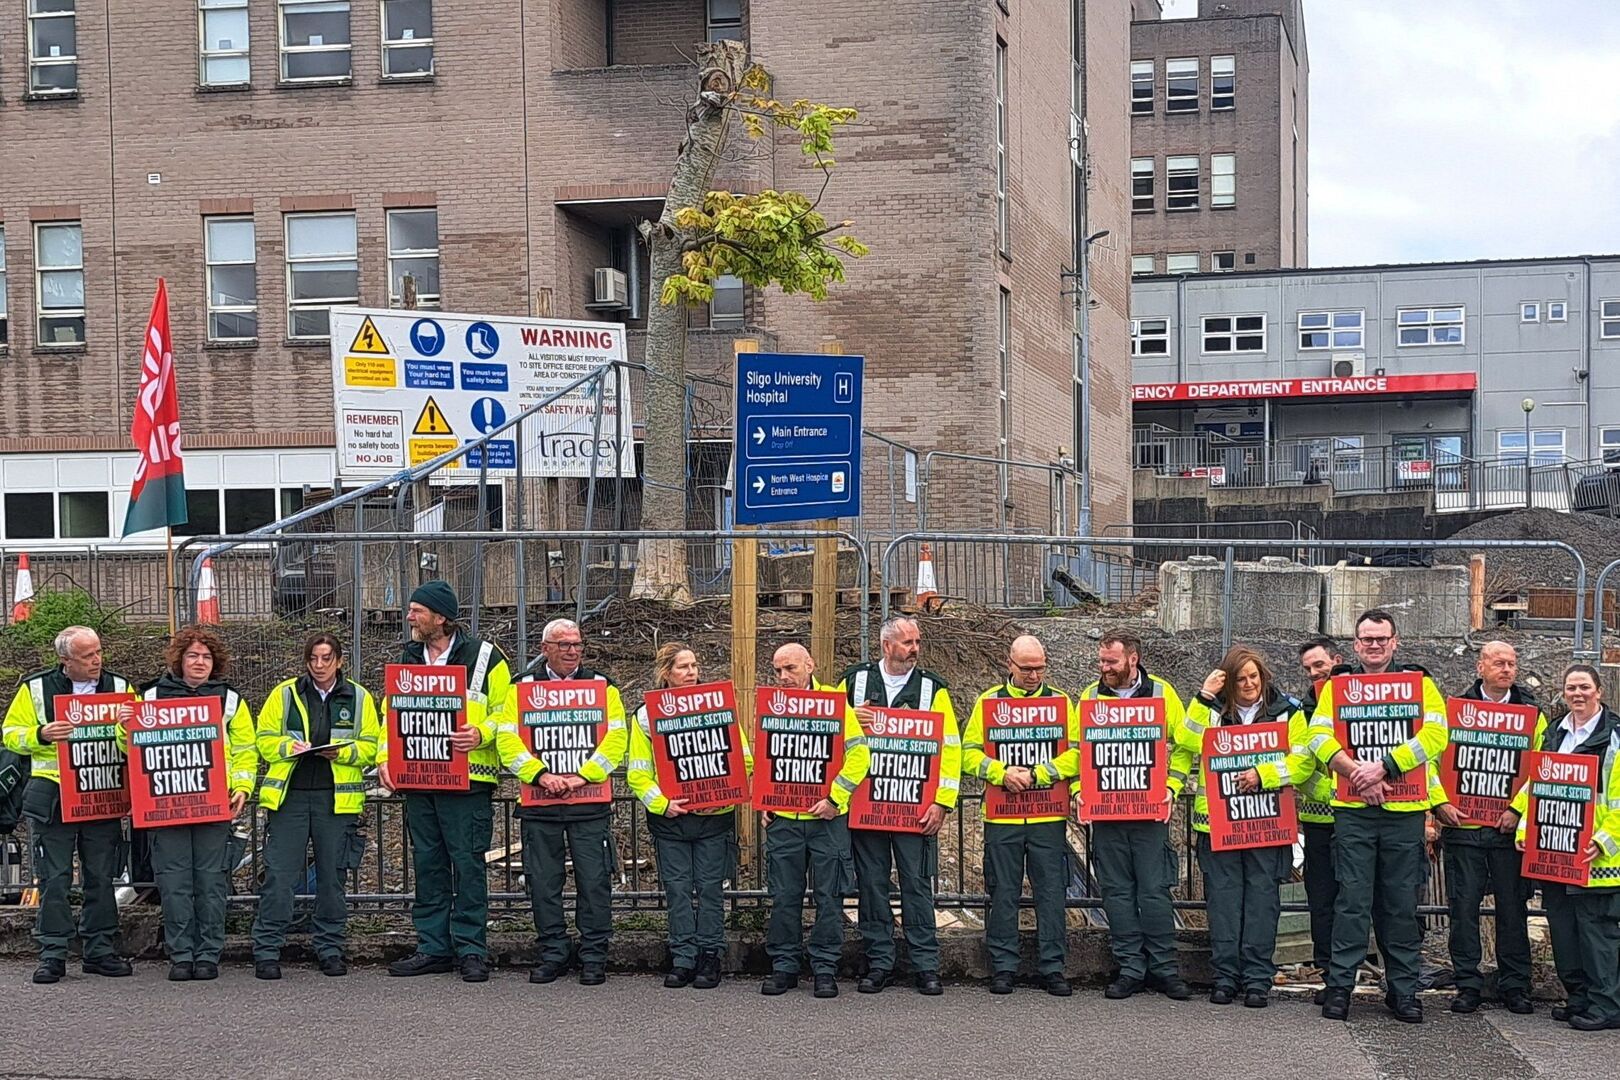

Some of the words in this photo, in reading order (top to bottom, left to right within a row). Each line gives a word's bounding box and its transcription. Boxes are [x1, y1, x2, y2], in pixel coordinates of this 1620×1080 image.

[521, 328, 612, 349] WARNING
[747, 371, 771, 388] Sligo
[775, 372, 821, 389] University
[839, 379, 847, 395] H
[1188, 382, 1292, 397] DEPARTMENT
[1302, 379, 1386, 392] ENTRANCE
[747, 390, 788, 406] Hospital
[545, 405, 572, 414] SAFETY
[576, 406, 584, 414] AT
[347, 415, 399, 425] REMEMBER
[772, 426, 791, 437] Main
[794, 426, 827, 436] Entrance
[359, 442, 379, 450] safety
[538, 431, 626, 457] tracey
[772, 441, 783, 449] Drop
[771, 474, 788, 483] North
[790, 474, 804, 482] West
[806, 473, 828, 483] Hospice
[771, 487, 797, 496] Entrance
[414, 676, 455, 692] SIPTU
[1364, 683, 1412, 701] SIPTU
[392, 696, 434, 708] AMBULANCE
[436, 697, 461, 708] SECTOR
[548, 689, 595, 706] SIPTU
[677, 691, 723, 712] SIPTU
[84, 704, 120, 721] SIPT
[788, 698, 834, 715] SIPTU
[1012, 706, 1057, 723] SIPTU
[1110, 706, 1154, 723] SIPTU
[1341, 706, 1387, 719] AMBULANCE
[1389, 705, 1418, 717] SECTOR
[159, 706, 209, 725] SIPTU
[401, 712, 454, 735] OFFICIAL
[524, 712, 571, 724] AMBULANCE
[573, 711, 602, 722] SECTOR
[657, 716, 703, 732] AMBULANCE
[704, 711, 733, 726] SECTOR
[1477, 711, 1524, 731] SIPTU
[762, 718, 808, 731] AMBULANCE
[811, 720, 839, 732] SECTOR
[888, 718, 933, 736] SIPTU
[989, 728, 1034, 740] AMBULANCE
[1036, 727, 1063, 738] SECTOR
[1086, 728, 1131, 740] AMBULANCE
[1133, 727, 1160, 738] SECTOR
[133, 730, 184, 744] AMBULANCE
[186, 727, 217, 740] SECTOR
[535, 725, 594, 750] OFFICIAL
[668, 728, 728, 757] OFFICIAL
[1233, 731, 1278, 751] SIPTU
[1451, 730, 1498, 747] AMBULANCE
[1500, 734, 1528, 748] SECTOR
[407, 737, 450, 759] STRIKE
[771, 733, 829, 758] OFFICIAL
[868, 737, 907, 751] MBULANCE
[910, 741, 937, 753] SECTOR
[1096, 742, 1152, 765] OFFICIAL
[145, 743, 210, 770] OFFICIAL
[1211, 755, 1256, 770] AMBULANCE
[1458, 746, 1516, 773] OFFICIAL
[421, 763, 450, 773] NATIONAL
[678, 753, 727, 780] STRIKE
[776, 759, 823, 783] STRIKE
[870, 753, 926, 778] OFFICIAL
[1552, 763, 1588, 782] SIPTU
[80, 766, 121, 790] STRIKE
[154, 768, 206, 795] STRIKE
[397, 774, 434, 785] AMBULANCE
[436, 775, 462, 785] SERVICE
[697, 779, 729, 791] NATIONAL
[1101, 767, 1147, 790] STRIKE
[1461, 771, 1509, 797] STRIKE
[715, 788, 742, 800] SERVICE
[789, 785, 822, 797] NATIONAL
[874, 778, 920, 802] STRIKE
[1116, 793, 1147, 803] NATIONAL
[1533, 783, 1567, 797] AMBULANCE
[1569, 787, 1591, 800] SECTOR
[762, 796, 802, 806] AMBULANCE
[995, 803, 1035, 815] AMBULANCE
[1037, 802, 1063, 813] SERVICE
[1090, 805, 1130, 815] AMBULANCE
[1133, 804, 1160, 815] SERVICE
[1230, 793, 1277, 819] STRIKE
[1475, 799, 1507, 810] NATIONAL
[72, 804, 108, 817] AMBULANCE
[887, 805, 918, 816] NATIONAL
[1538, 799, 1582, 827] OFFICIAL
[860, 815, 899, 825] AMBULANCE
[1232, 822, 1244, 833] HSE
[1247, 820, 1279, 832] NATIONAL
[1222, 832, 1261, 846] AMBULANCE
[1264, 829, 1291, 841] SERVICE
[1540, 826, 1576, 852] STRIKE
